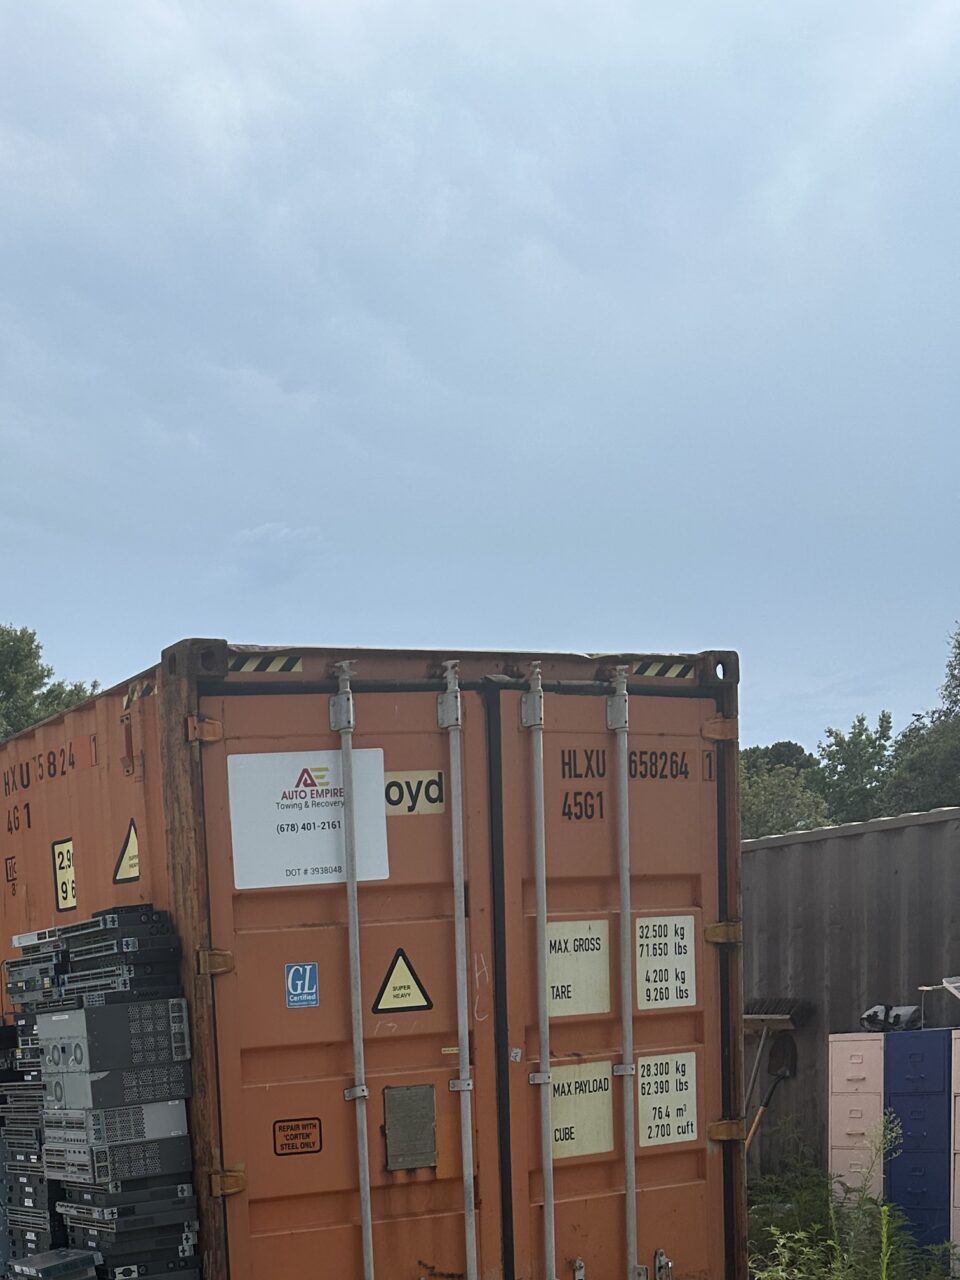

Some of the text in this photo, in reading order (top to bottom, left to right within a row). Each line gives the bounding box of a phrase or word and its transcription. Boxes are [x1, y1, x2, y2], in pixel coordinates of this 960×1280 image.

[560, 749, 607, 779] HLXU
[629, 750, 689, 780] 658264
[281, 787, 345, 801] AUTO EMPIRE
[275, 799, 345, 811] Towing & Recovery
[561, 790, 605, 821] 45G1
[276, 820, 342, 835] (678) 401-2161
[285, 865, 343, 877] DOT # 3938048
[639, 923, 685, 940] 32.500 kg
[549, 936, 601, 954] MAX. GROSS
[639, 942, 688, 958] 71.650 lbs
[287, 965, 317, 995] GL
[645, 967, 686, 984] 4.200 kg
[289, 994, 316, 1002] Certified
[550, 984, 572, 1000] TARE
[645, 984, 689, 1002] 9.260 lbs
[640, 1060, 687, 1078] 28.300 kg
[640, 1078, 689, 1096] 62.390 lbs
[652, 1105, 671, 1121] 76.4
[278, 1122, 317, 1132] REPAIR WITH
[554, 1126, 576, 1142] CUBE
[647, 1121, 694, 1140] 2.700 cuft
[280, 1141, 316, 1151] STEEL ONLY
